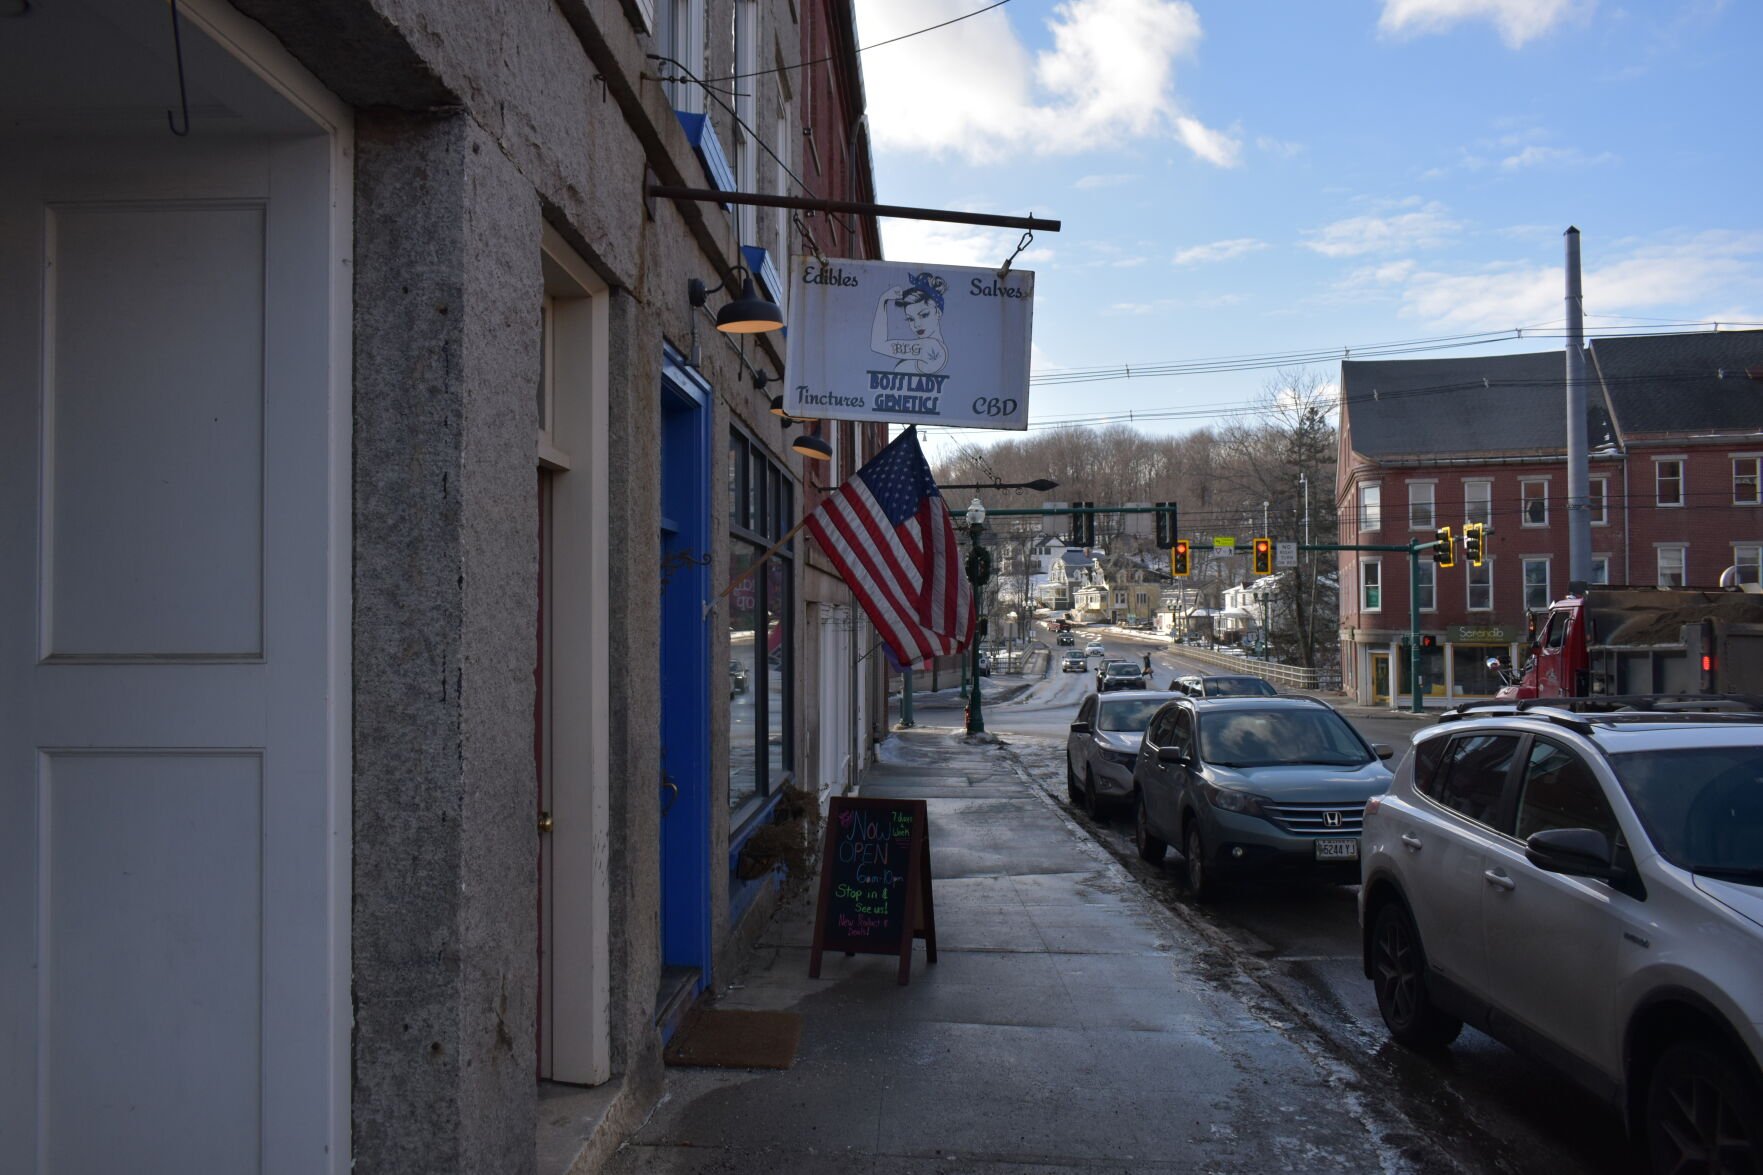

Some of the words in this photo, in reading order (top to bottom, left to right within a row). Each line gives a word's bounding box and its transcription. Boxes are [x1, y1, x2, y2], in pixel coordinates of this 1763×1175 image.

[802, 266, 858, 287] Edibles
[969, 278, 1023, 299] Salves
[870, 373, 904, 392] BOSS
[907, 375, 945, 394] LADY
[796, 385, 865, 408] Tinctures
[874, 393, 939, 412] GENETICS
[972, 396, 1018, 417] CBD
[839, 841, 889, 865] OPEN
[835, 883, 863, 901] Stop
[867, 889, 878, 899] in
